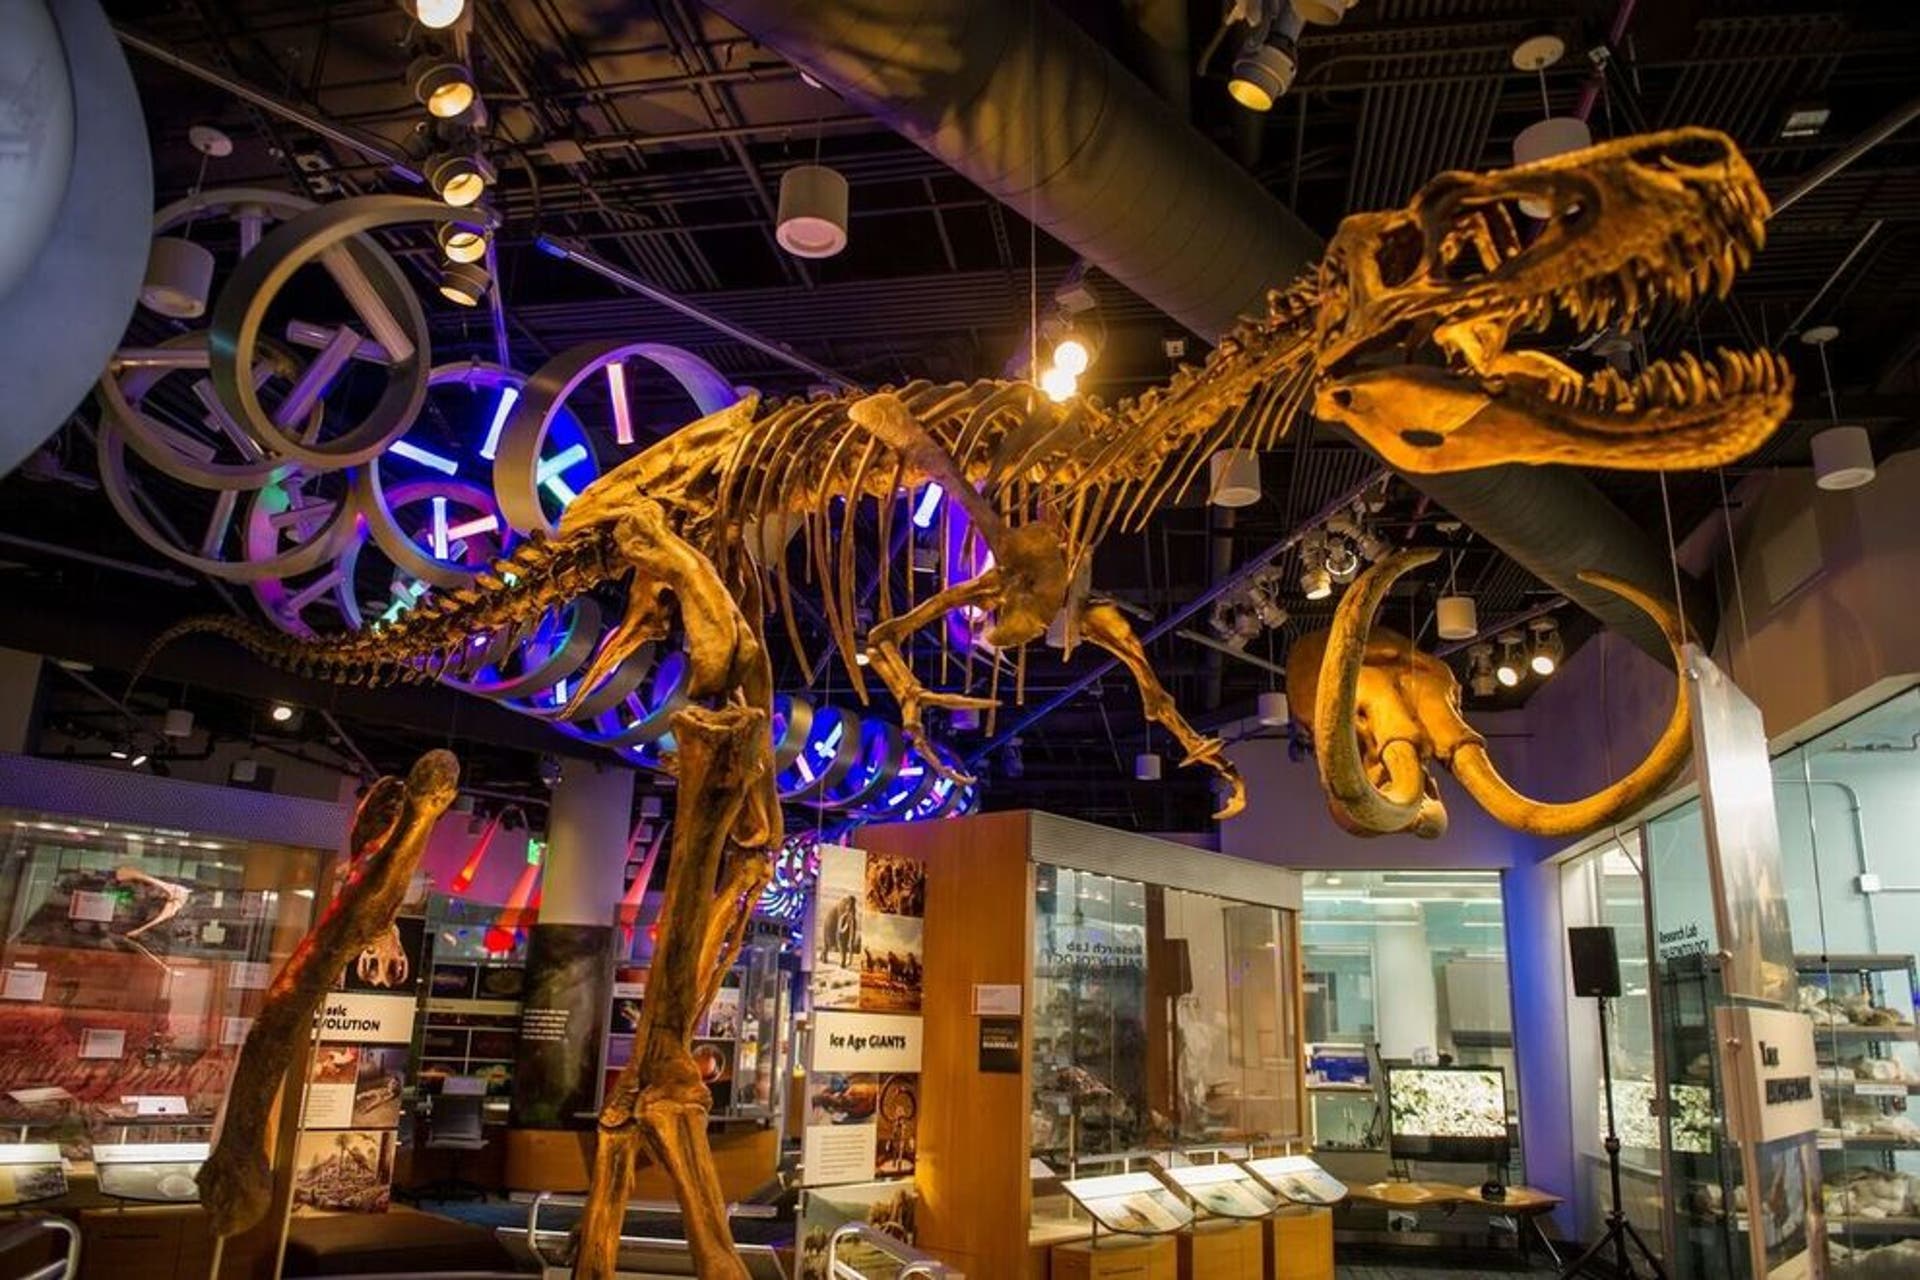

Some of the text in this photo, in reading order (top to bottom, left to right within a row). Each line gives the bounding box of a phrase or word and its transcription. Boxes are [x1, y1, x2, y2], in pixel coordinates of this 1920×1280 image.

[830, 1032, 907, 1052] Ice Age GIANTS
